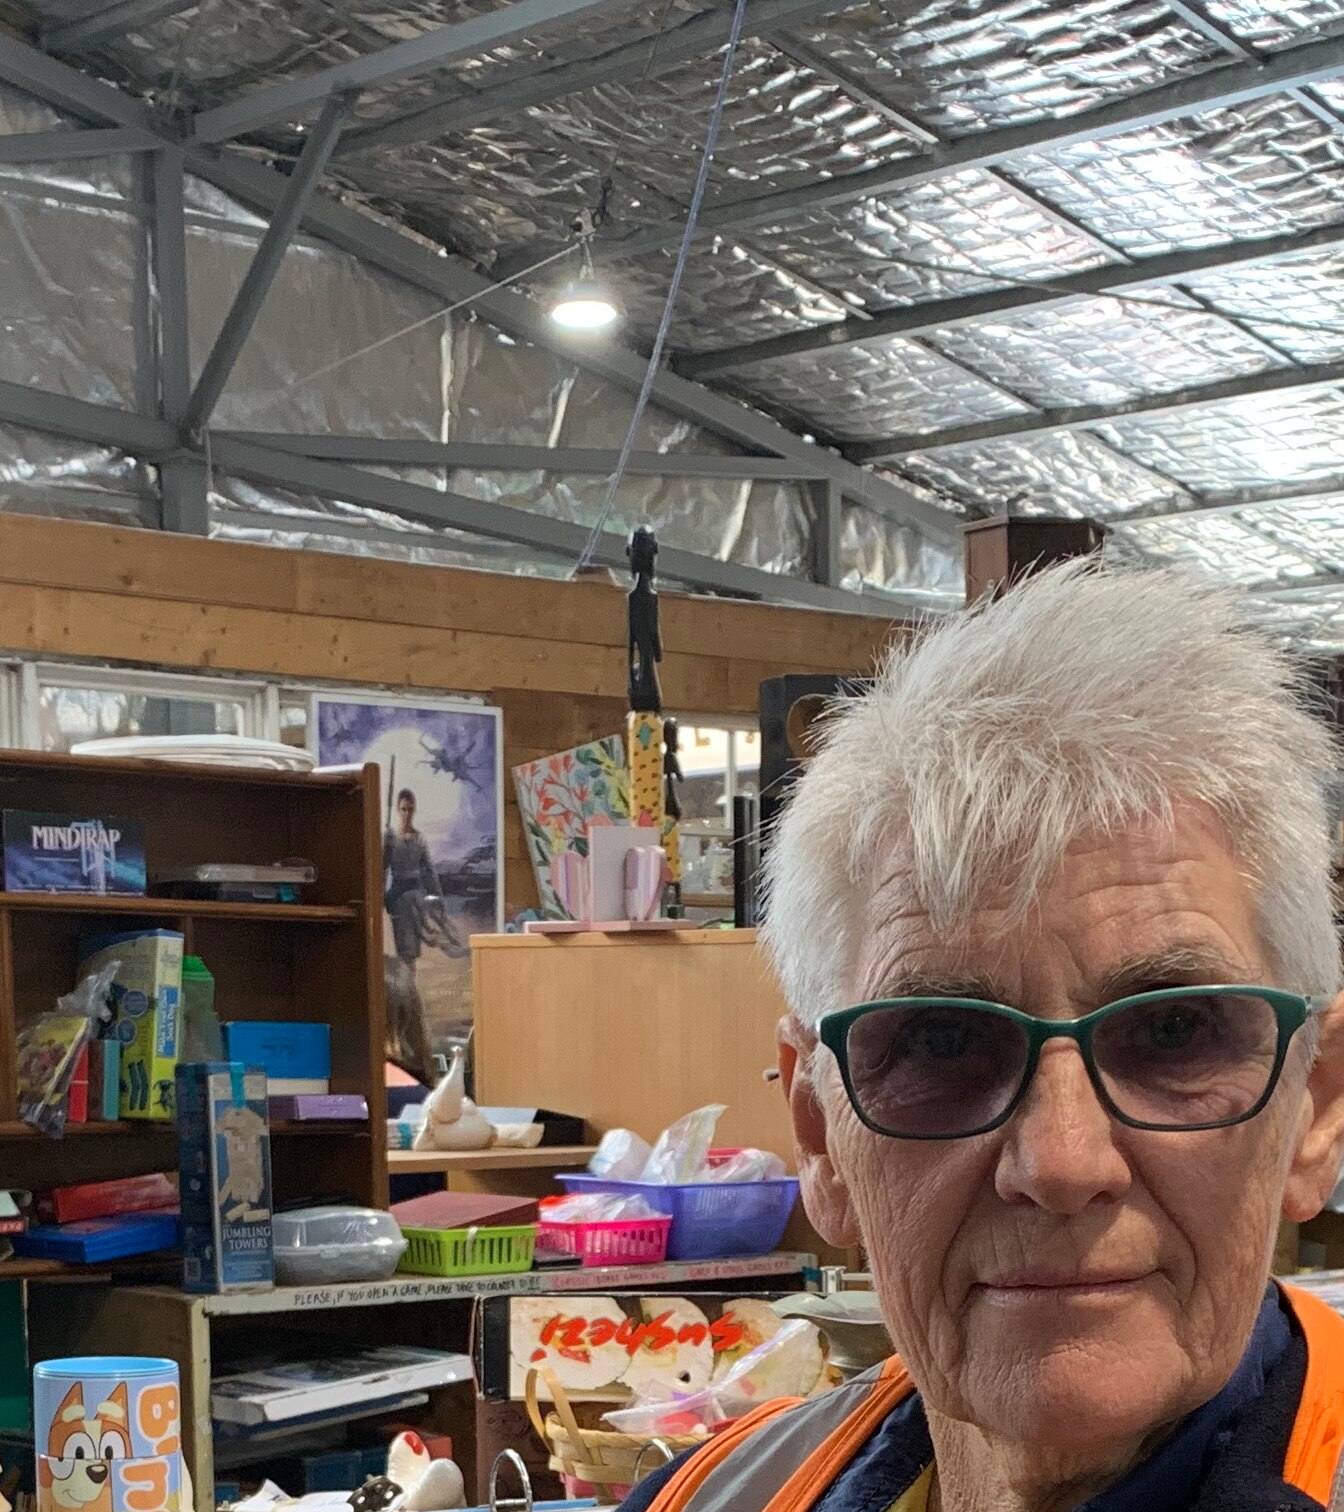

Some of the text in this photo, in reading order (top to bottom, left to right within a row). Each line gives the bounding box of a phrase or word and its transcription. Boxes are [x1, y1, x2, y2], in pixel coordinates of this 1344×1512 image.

[30, 823, 121, 851] MINDTRAP
[222, 1226, 271, 1240] JUMBLING
[228, 1239, 268, 1249] TOWERS
[347, 1289, 363, 1301] YOU
[368, 1288, 388, 1298] OPEN
[392, 1287, 399, 1296] A
